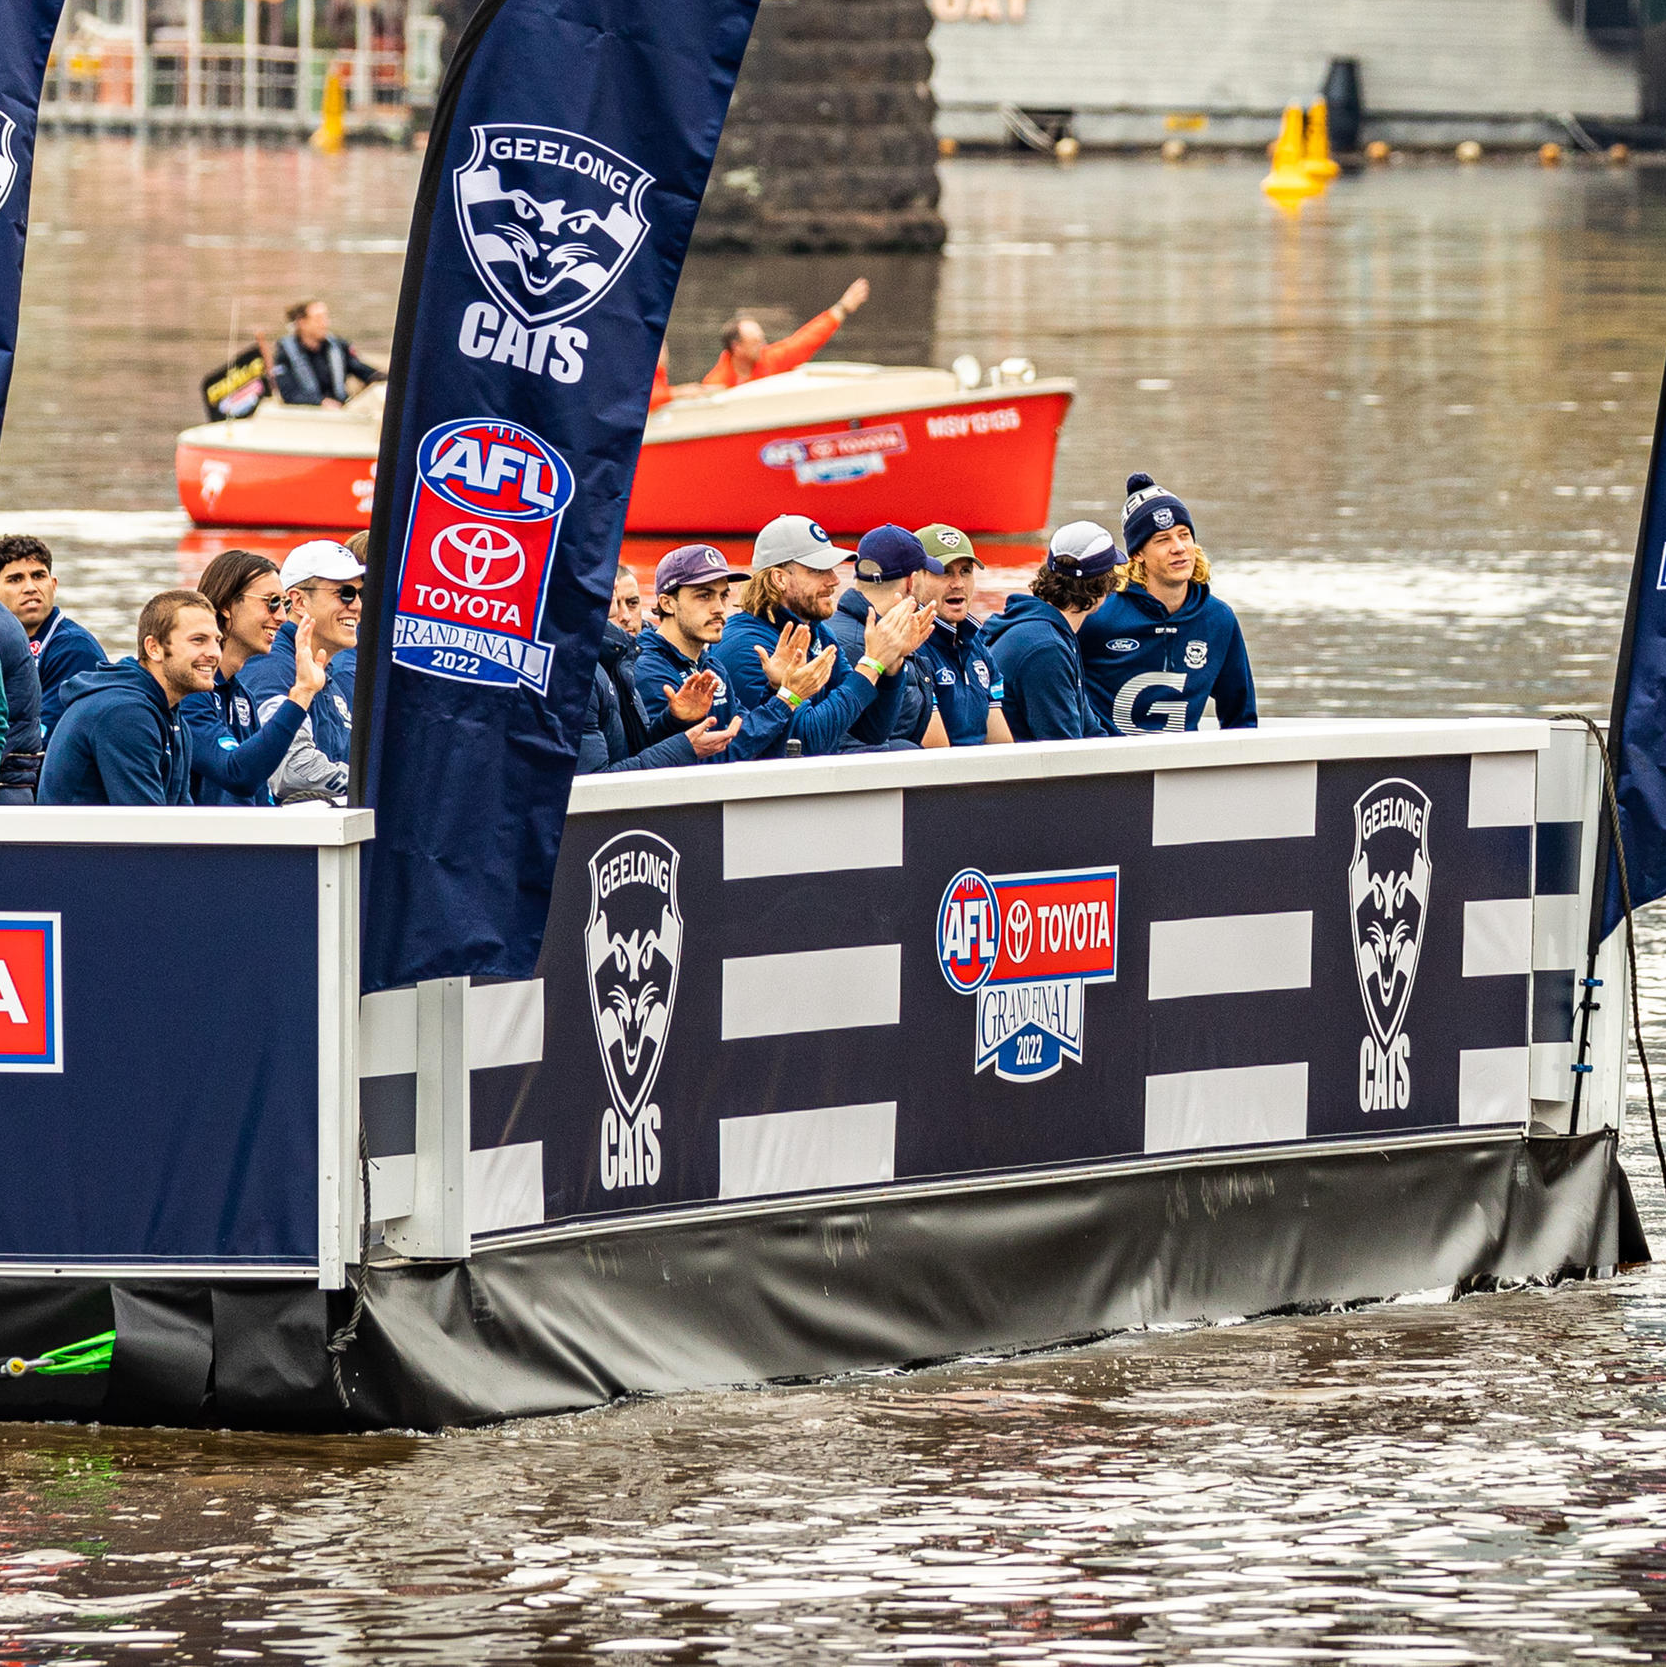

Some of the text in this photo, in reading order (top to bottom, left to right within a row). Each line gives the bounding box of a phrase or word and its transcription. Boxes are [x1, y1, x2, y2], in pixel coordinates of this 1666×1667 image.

[489, 137, 632, 196] GEELONG
[458, 301, 589, 384] CATS
[427, 435, 555, 510] AFL
[415, 583, 522, 628] TOYOTA
[430, 649, 481, 675] 2022
[463, 632, 542, 679] FINAL
[1112, 671, 1188, 736] G
[1362, 797, 1422, 840] GEELONG
[599, 850, 669, 898] GEELONG
[942, 900, 1111, 961] AFL TOYOTA
[982, 984, 1079, 1049] GRAND FINAL
[1016, 1034, 1043, 1066] 2022
[1359, 1033, 1410, 1113] CATS
[600, 1103, 662, 1190] CATS
